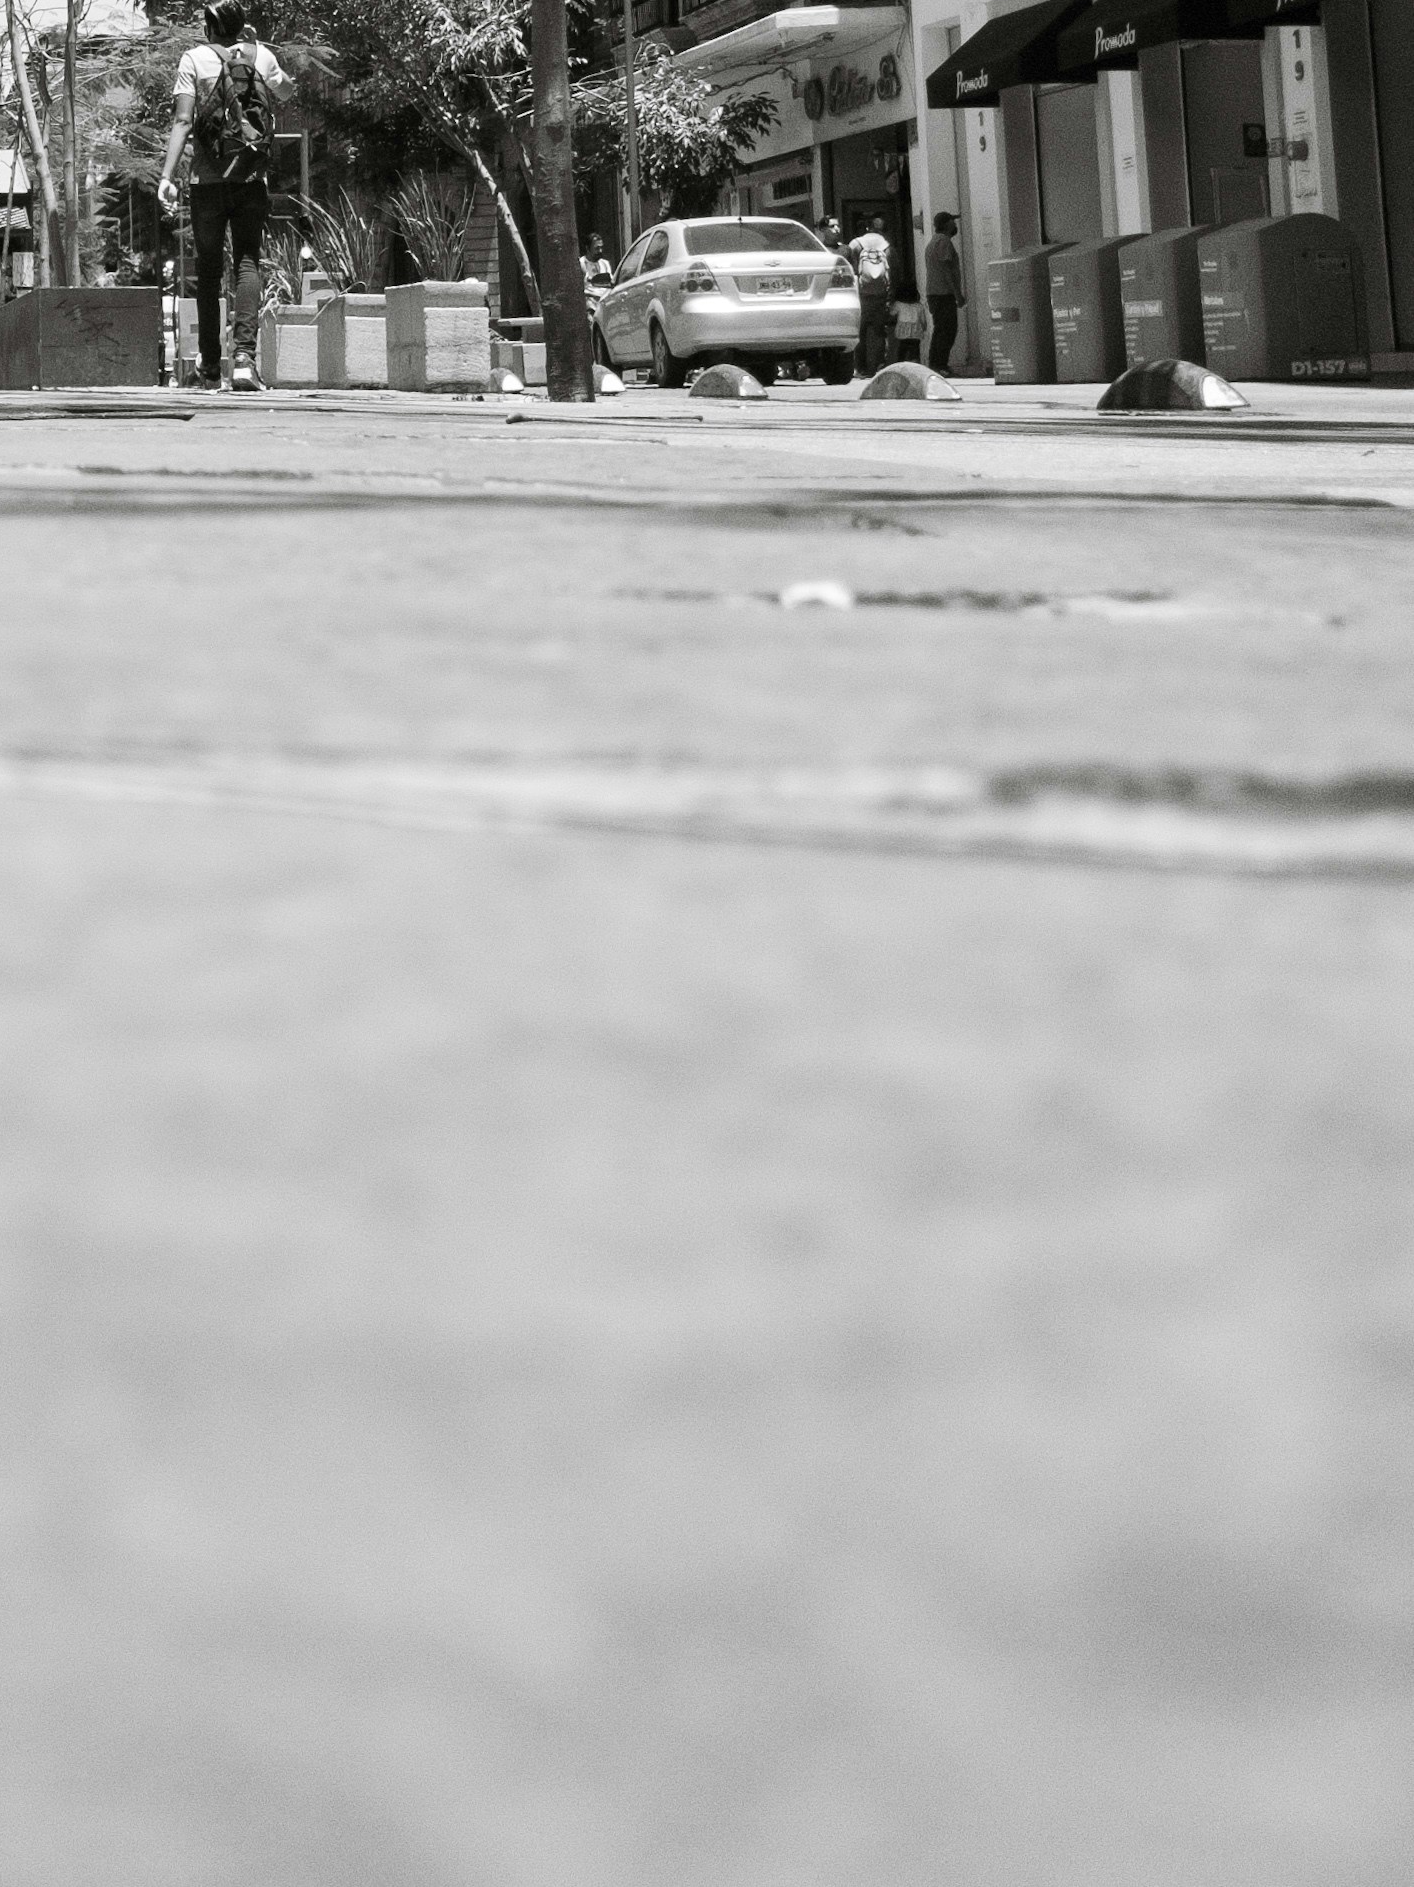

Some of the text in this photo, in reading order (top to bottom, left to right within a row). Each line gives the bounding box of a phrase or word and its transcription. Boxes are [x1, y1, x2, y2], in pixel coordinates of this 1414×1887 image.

[1094, 22, 1136, 61] Promoda
[956, 68, 989, 100] Promoda
[1291, 359, 1346, 376] D1-157
